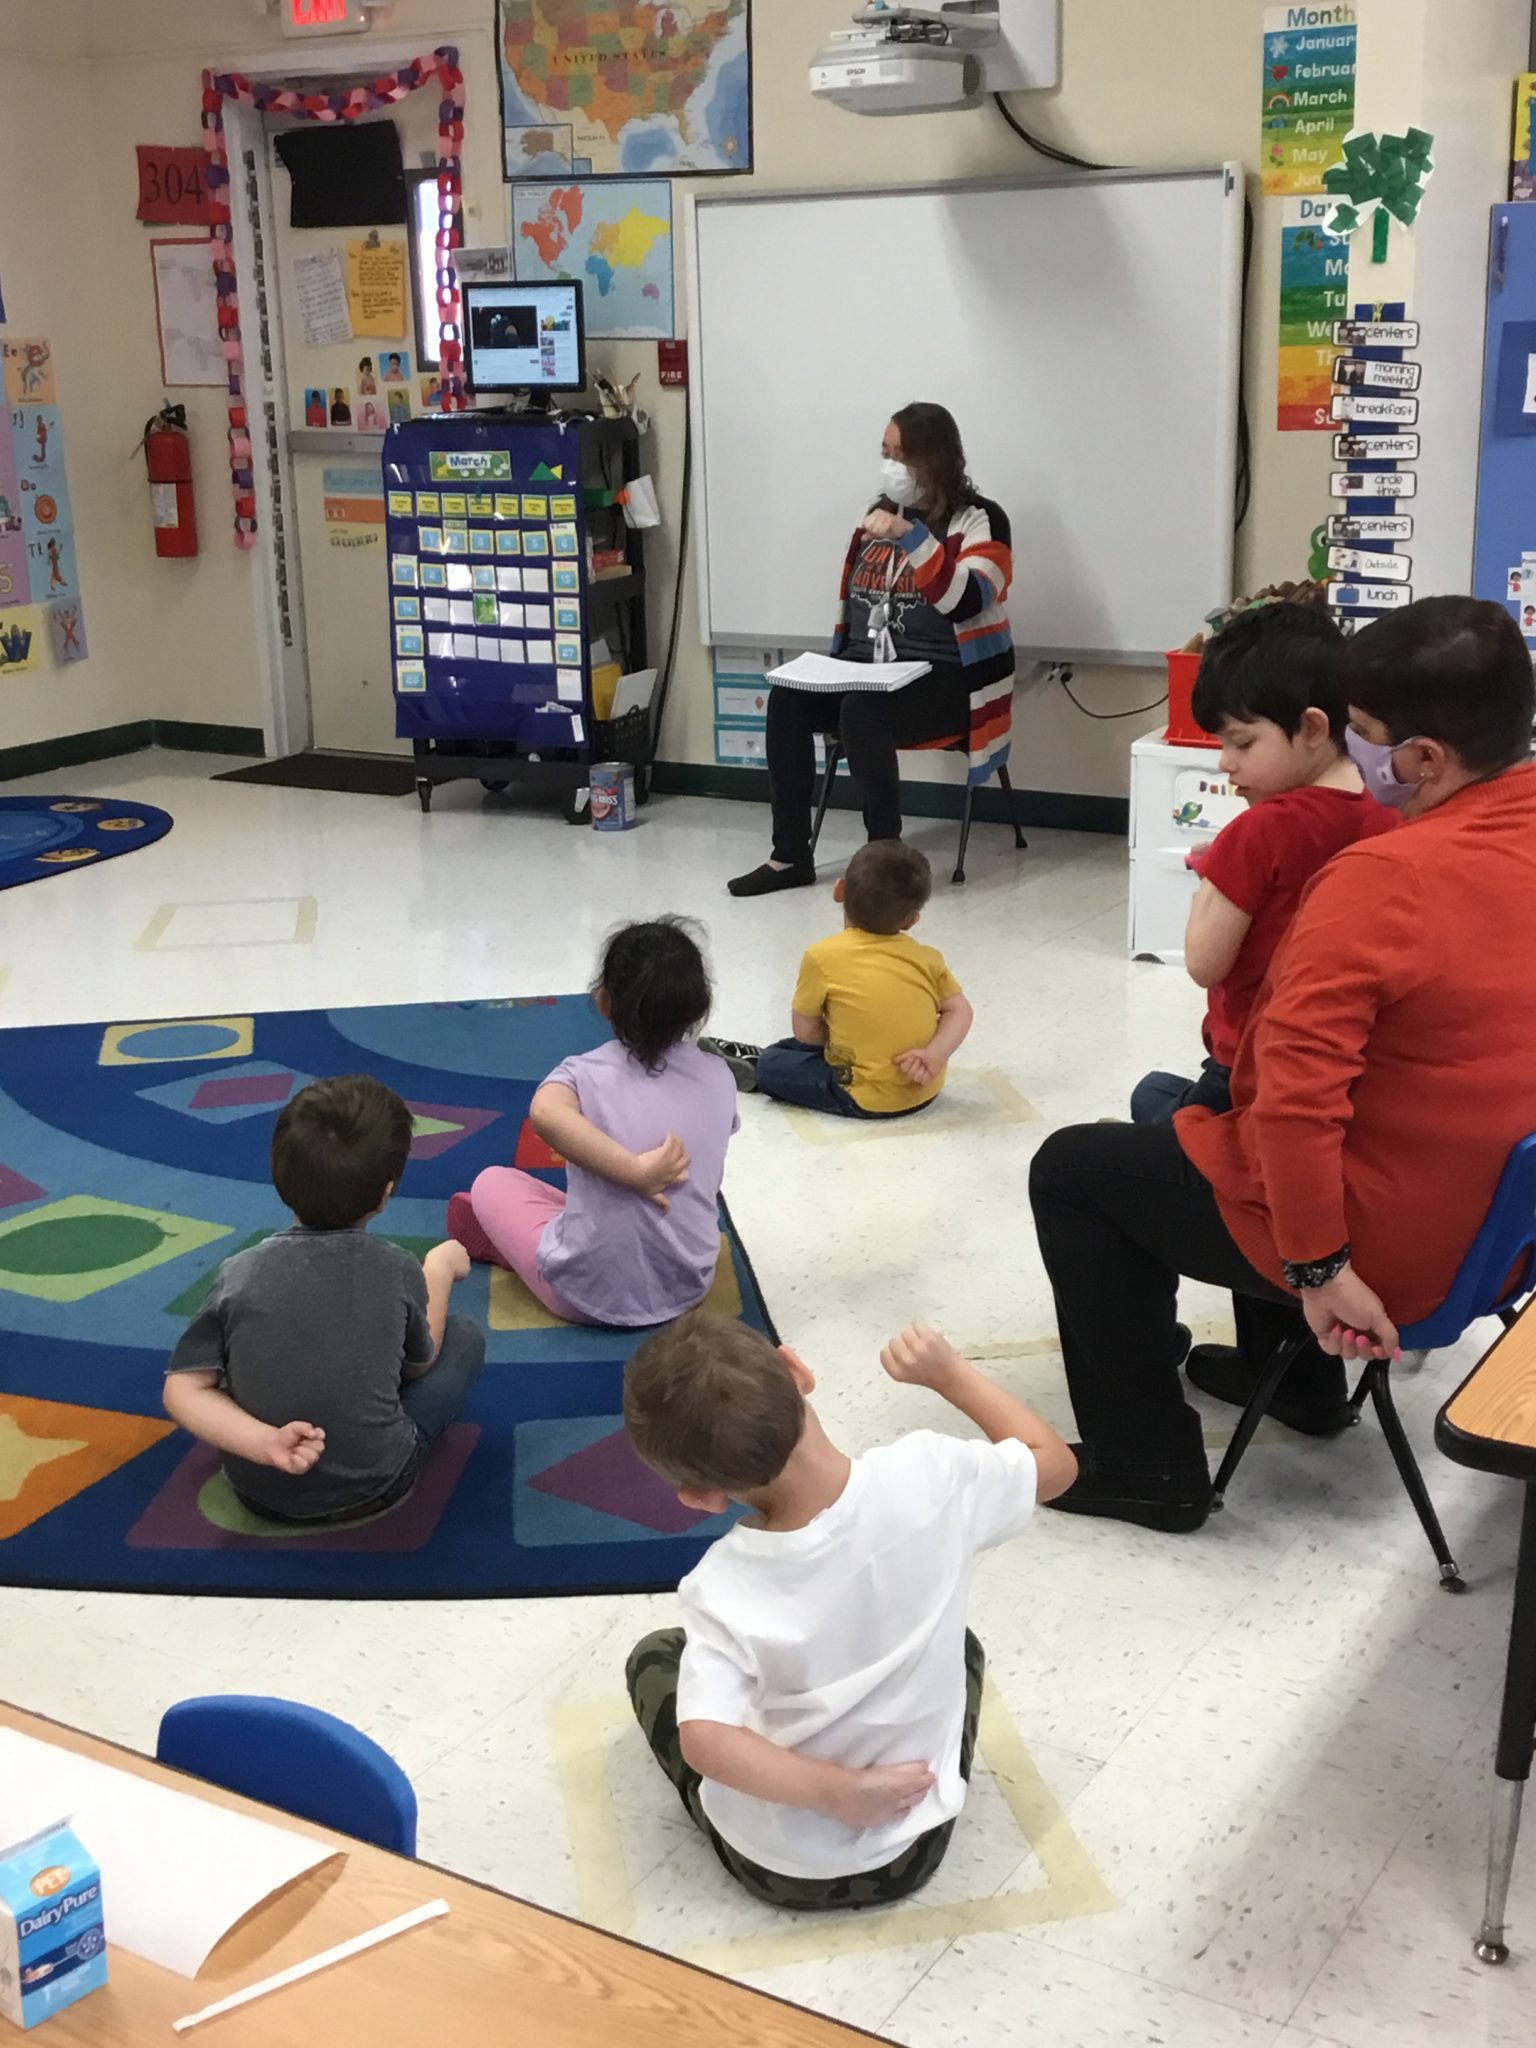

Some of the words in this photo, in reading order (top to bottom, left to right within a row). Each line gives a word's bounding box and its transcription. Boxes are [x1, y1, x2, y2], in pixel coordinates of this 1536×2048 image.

[1287, 4, 1355, 27] Month
[1296, 35, 1355, 50] Januar
[553, 53, 607, 64] UNITED
[612, 50, 666, 60] STATES
[1294, 89, 1347, 107] March
[1295, 117, 1334, 136] April
[1293, 148, 1328, 164] May
[144, 161, 203, 205] 304
[1294, 172, 1321, 188] Jun
[1365, 326, 1415, 339] centers
[661, 371, 682, 379] FIRE
[1375, 363, 1415, 376] morning
[1373, 374, 1413, 388] meeting
[1356, 403, 1413, 416] breakfast
[1366, 439, 1415, 451] centers
[449, 455, 487, 467] March
[1375, 474, 1403, 485] circle
[1376, 485, 1401, 497] time
[1360, 520, 1408, 532] centers
[1367, 588, 1398, 600] lunch
[20, 1886, 97, 1938] DairyPure
